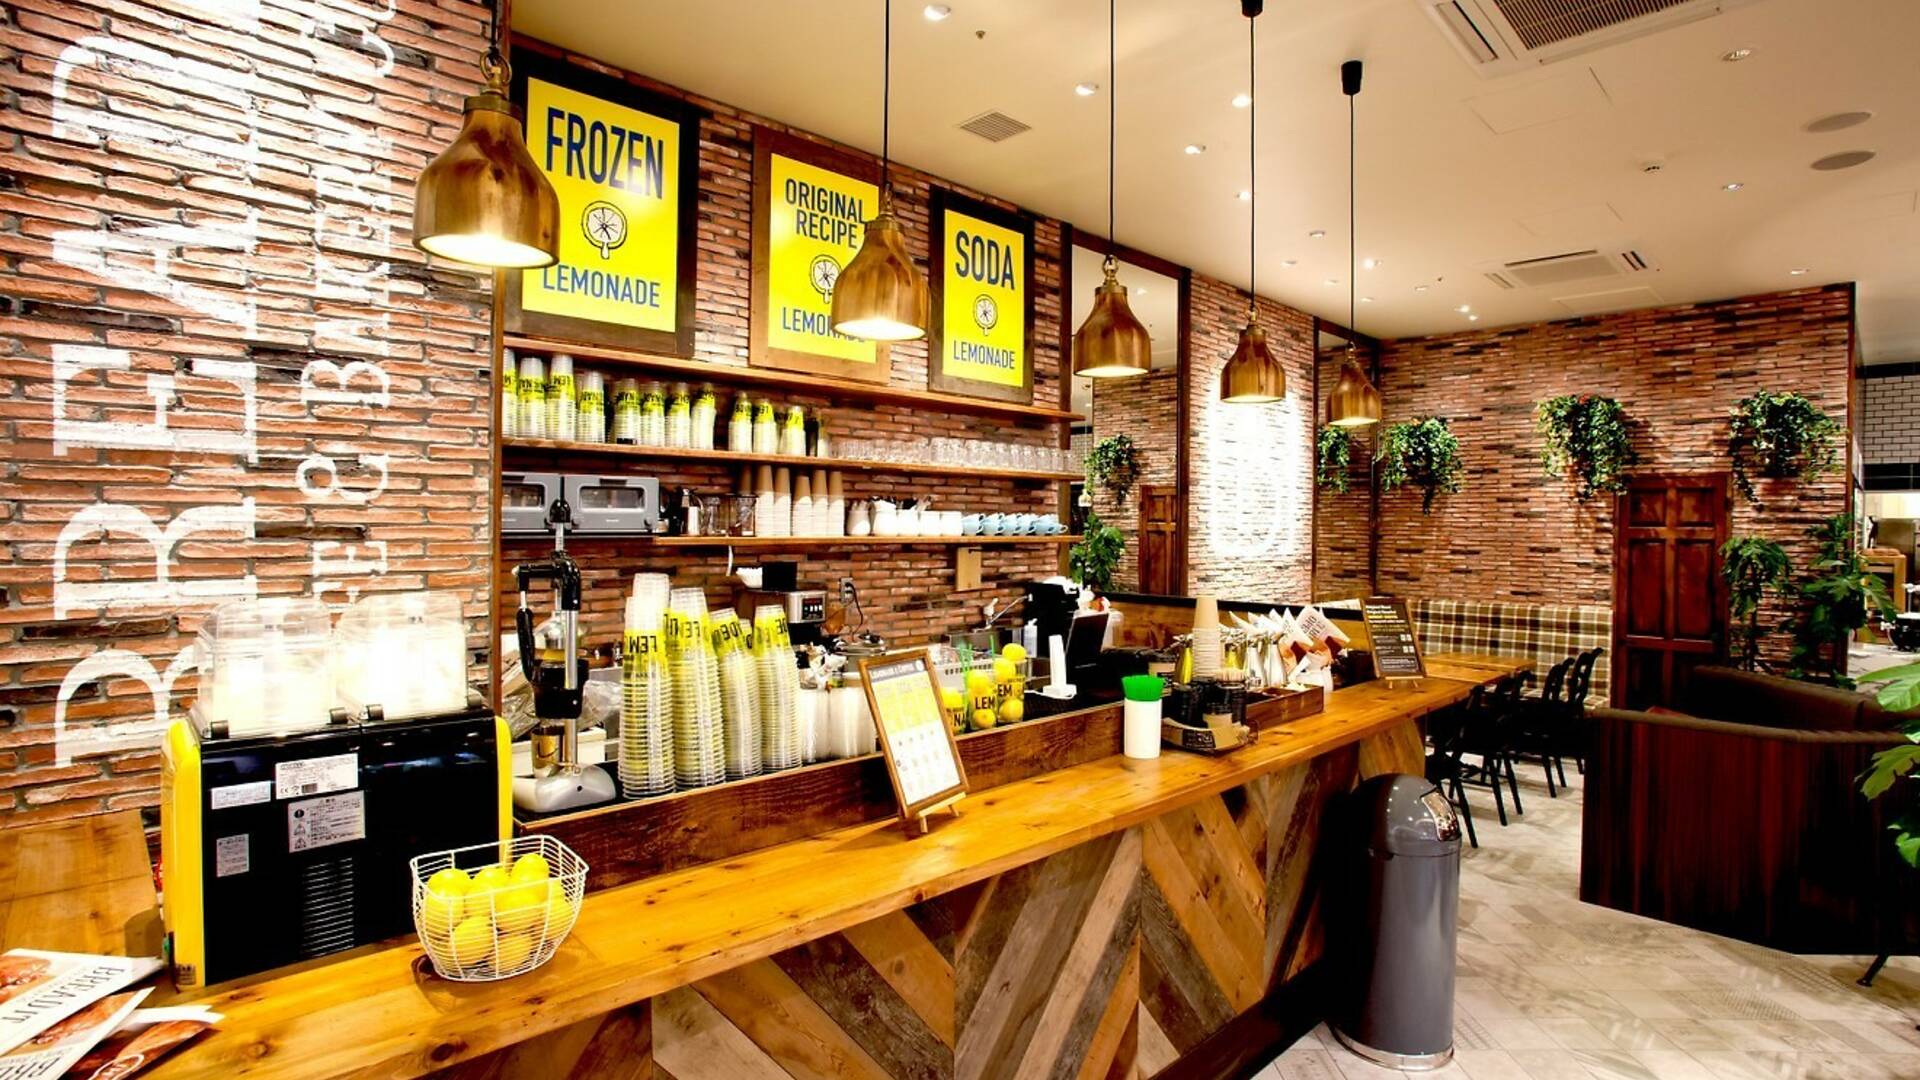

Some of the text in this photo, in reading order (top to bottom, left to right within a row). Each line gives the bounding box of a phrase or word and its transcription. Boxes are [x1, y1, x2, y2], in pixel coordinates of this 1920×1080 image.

[546, 106, 664, 200] FROZEN
[785, 178, 866, 224] ORIGINAL
[795, 210, 857, 249] RECIPE
[955, 230, 1015, 291] SODA
[542, 263, 661, 308] LEMONADE
[953, 338, 1016, 371] LEMONADE
